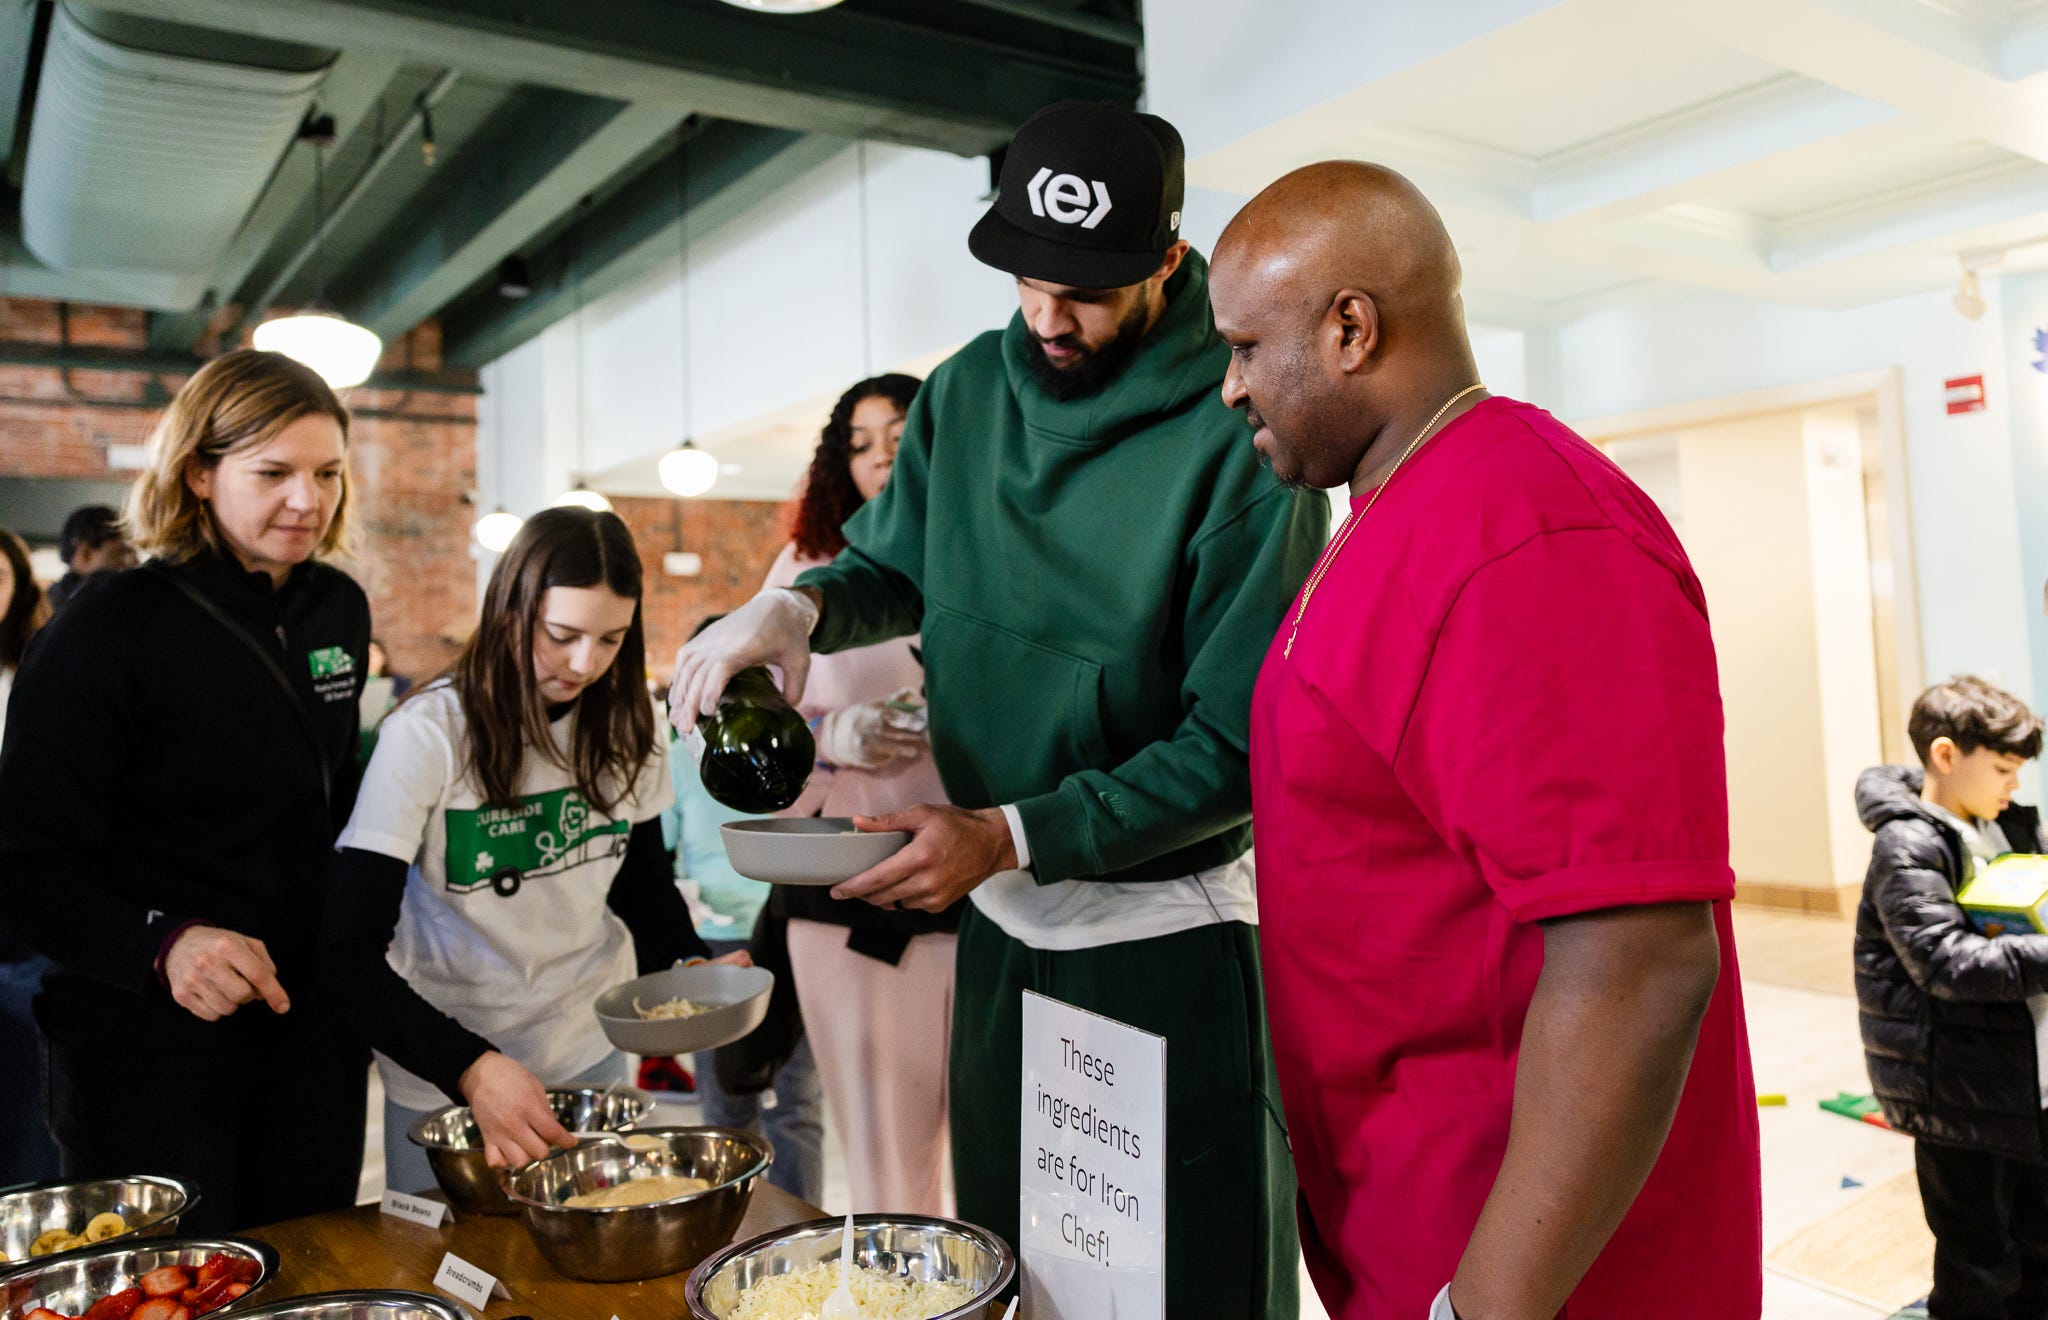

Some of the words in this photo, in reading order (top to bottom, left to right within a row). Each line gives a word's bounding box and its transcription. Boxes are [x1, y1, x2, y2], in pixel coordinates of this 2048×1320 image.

[476, 802, 543, 827] URBDE
[488, 819, 526, 838] CARE
[1060, 1037, 1115, 1087] These
[1037, 1083, 1141, 1160] ingredients
[1037, 1146, 1064, 1181] are
[1069, 1155, 1096, 1197] for
[1101, 1172, 1140, 1222] Iron
[1060, 1212, 1110, 1268] Chef!
[446, 1265, 483, 1293] Breadcrumbs
